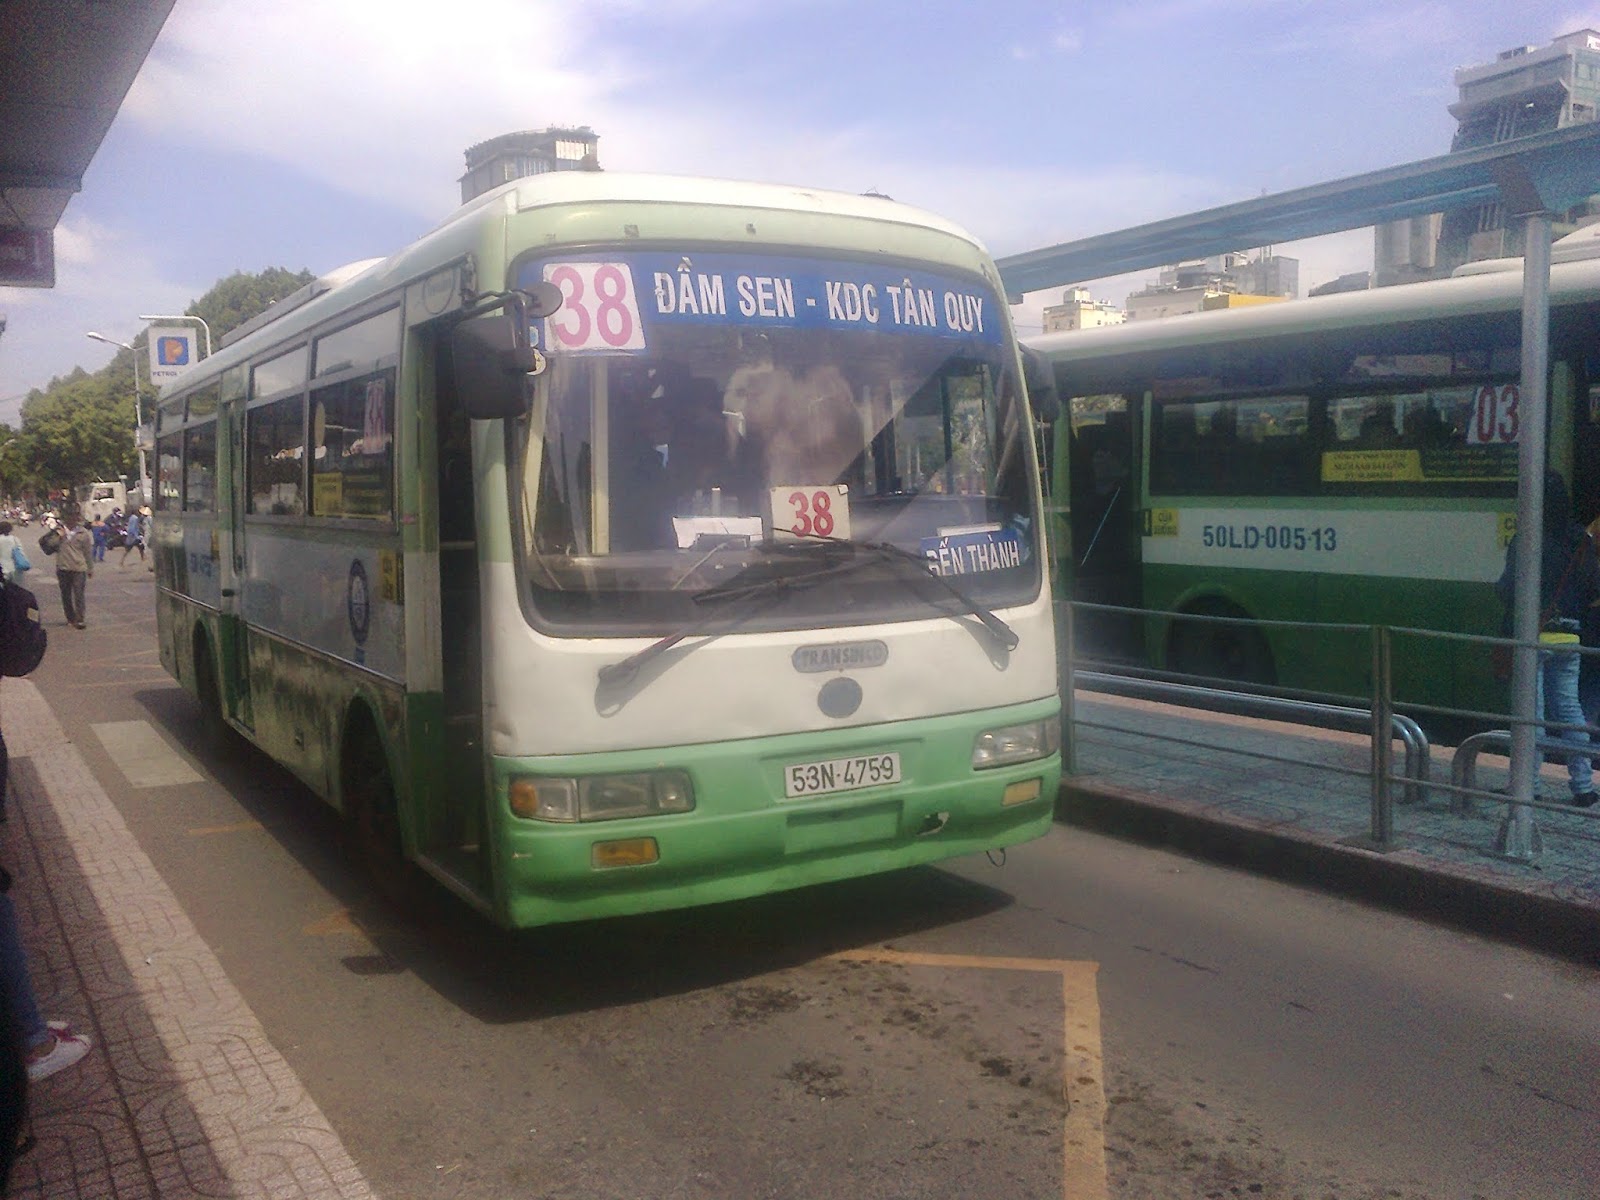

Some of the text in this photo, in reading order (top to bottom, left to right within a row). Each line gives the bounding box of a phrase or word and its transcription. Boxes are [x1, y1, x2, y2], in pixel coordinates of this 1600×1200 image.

[551, 264, 634, 347] 38
[736, 275, 796, 317] SEN
[827, 280, 881, 324] KDC
[886, 277, 937, 327] TÂN
[944, 291, 984, 333] QUY
[1477, 383, 1520, 443] 03
[787, 490, 836, 538] 38
[966, 534, 1020, 573] THÀNH
